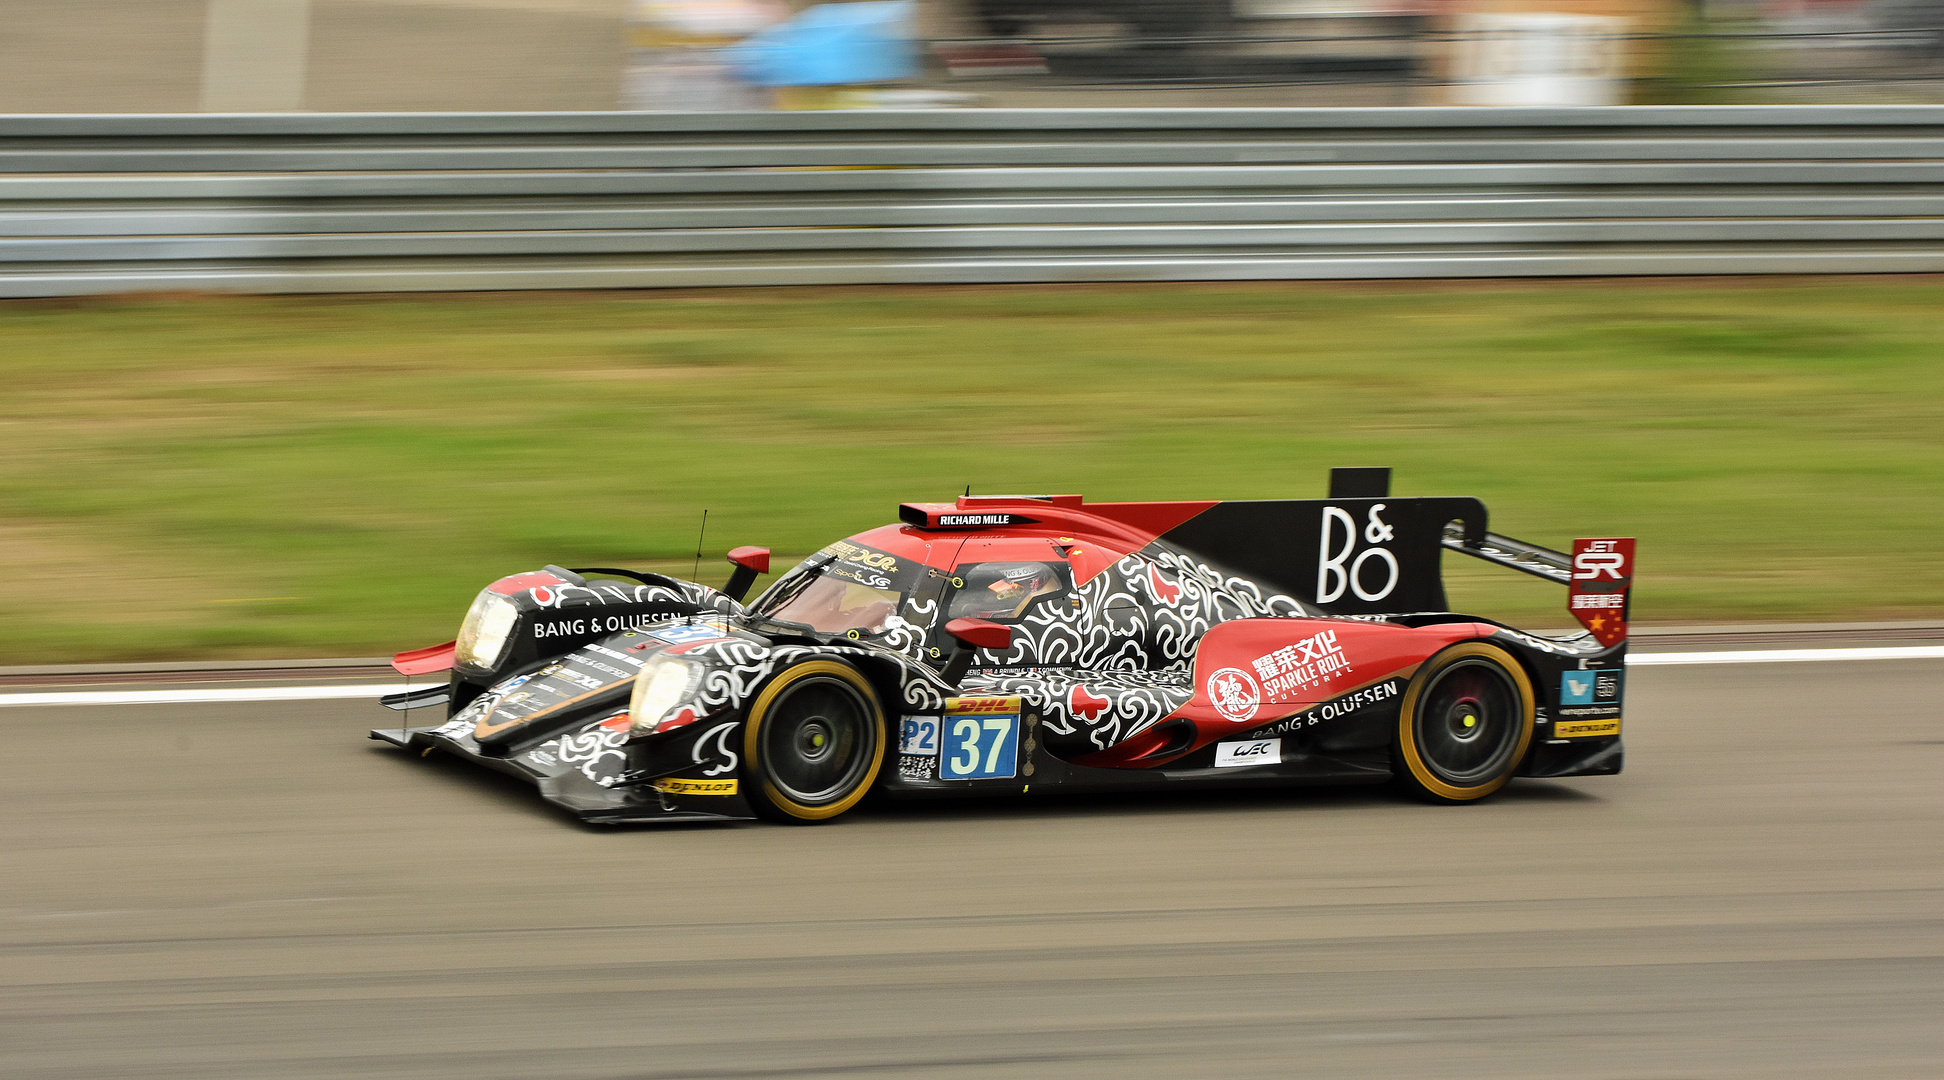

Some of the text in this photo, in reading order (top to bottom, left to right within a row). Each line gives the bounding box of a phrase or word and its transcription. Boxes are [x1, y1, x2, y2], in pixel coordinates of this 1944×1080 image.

[940, 514, 1010, 526] RICHARD MILLE
[1584, 540, 1618, 553] JET
[1573, 552, 1625, 580] SR
[534, 619, 585, 639] BANG
[590, 618, 602, 633] &
[1263, 651, 1350, 697] SPARKLE ROLL
[1270, 667, 1354, 704] CULTURAL
[957, 699, 1011, 713] DHL
[1252, 681, 1399, 740] BANG & OLUFSEN
[904, 720, 935, 749] P2
[950, 718, 1012, 775] 37
[1232, 742, 1272, 757] WEC
[669, 782, 734, 791] DUNLOP
